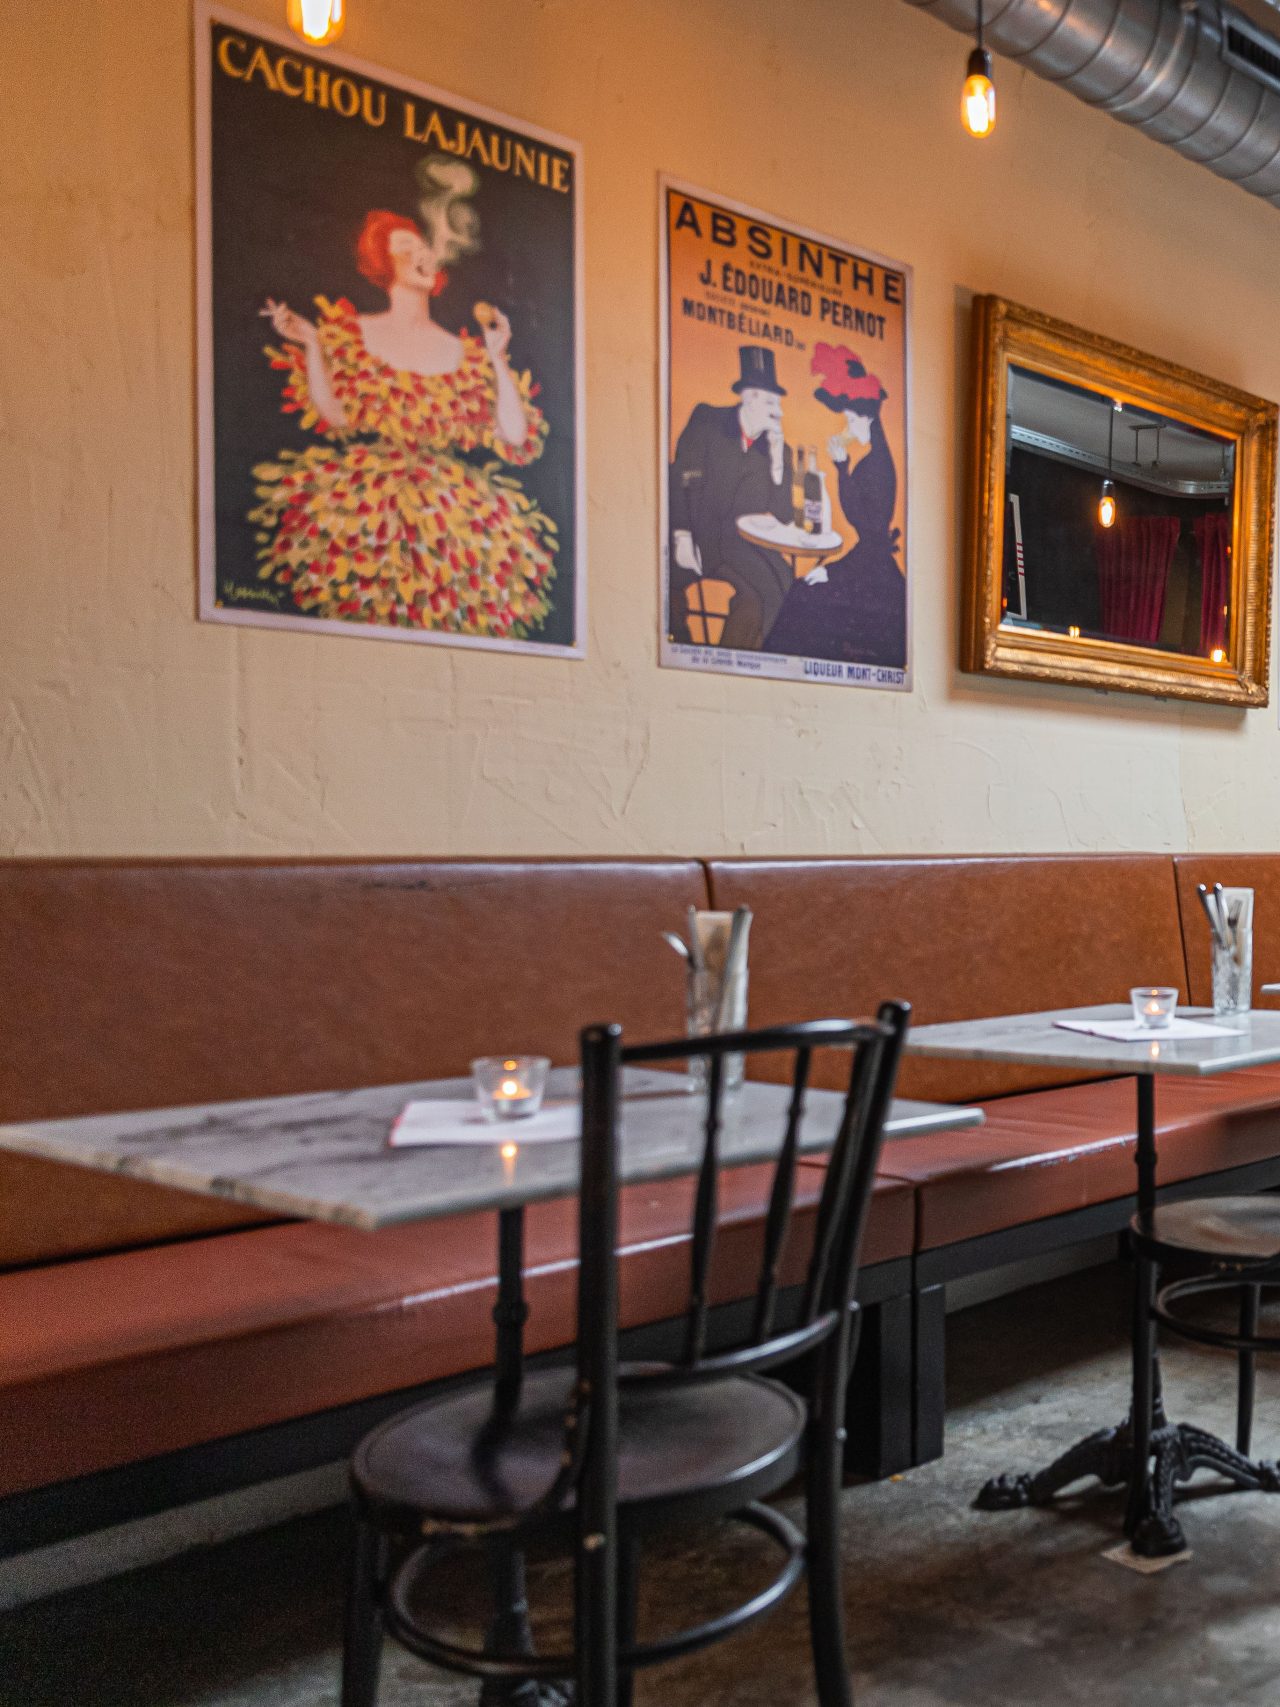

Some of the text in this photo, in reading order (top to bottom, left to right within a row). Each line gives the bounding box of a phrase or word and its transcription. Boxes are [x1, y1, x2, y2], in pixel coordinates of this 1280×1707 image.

[216, 35, 571, 194] CACHOU LAJAUNIE
[675, 200, 901, 305] ABSINTHE
[699, 259, 717, 288] J.
[721, 261, 812, 317] ÉDOUARD
[819, 297, 886, 341] PERNOT
[803, 660, 906, 685] LIQUEUR MONT-CHRIST
